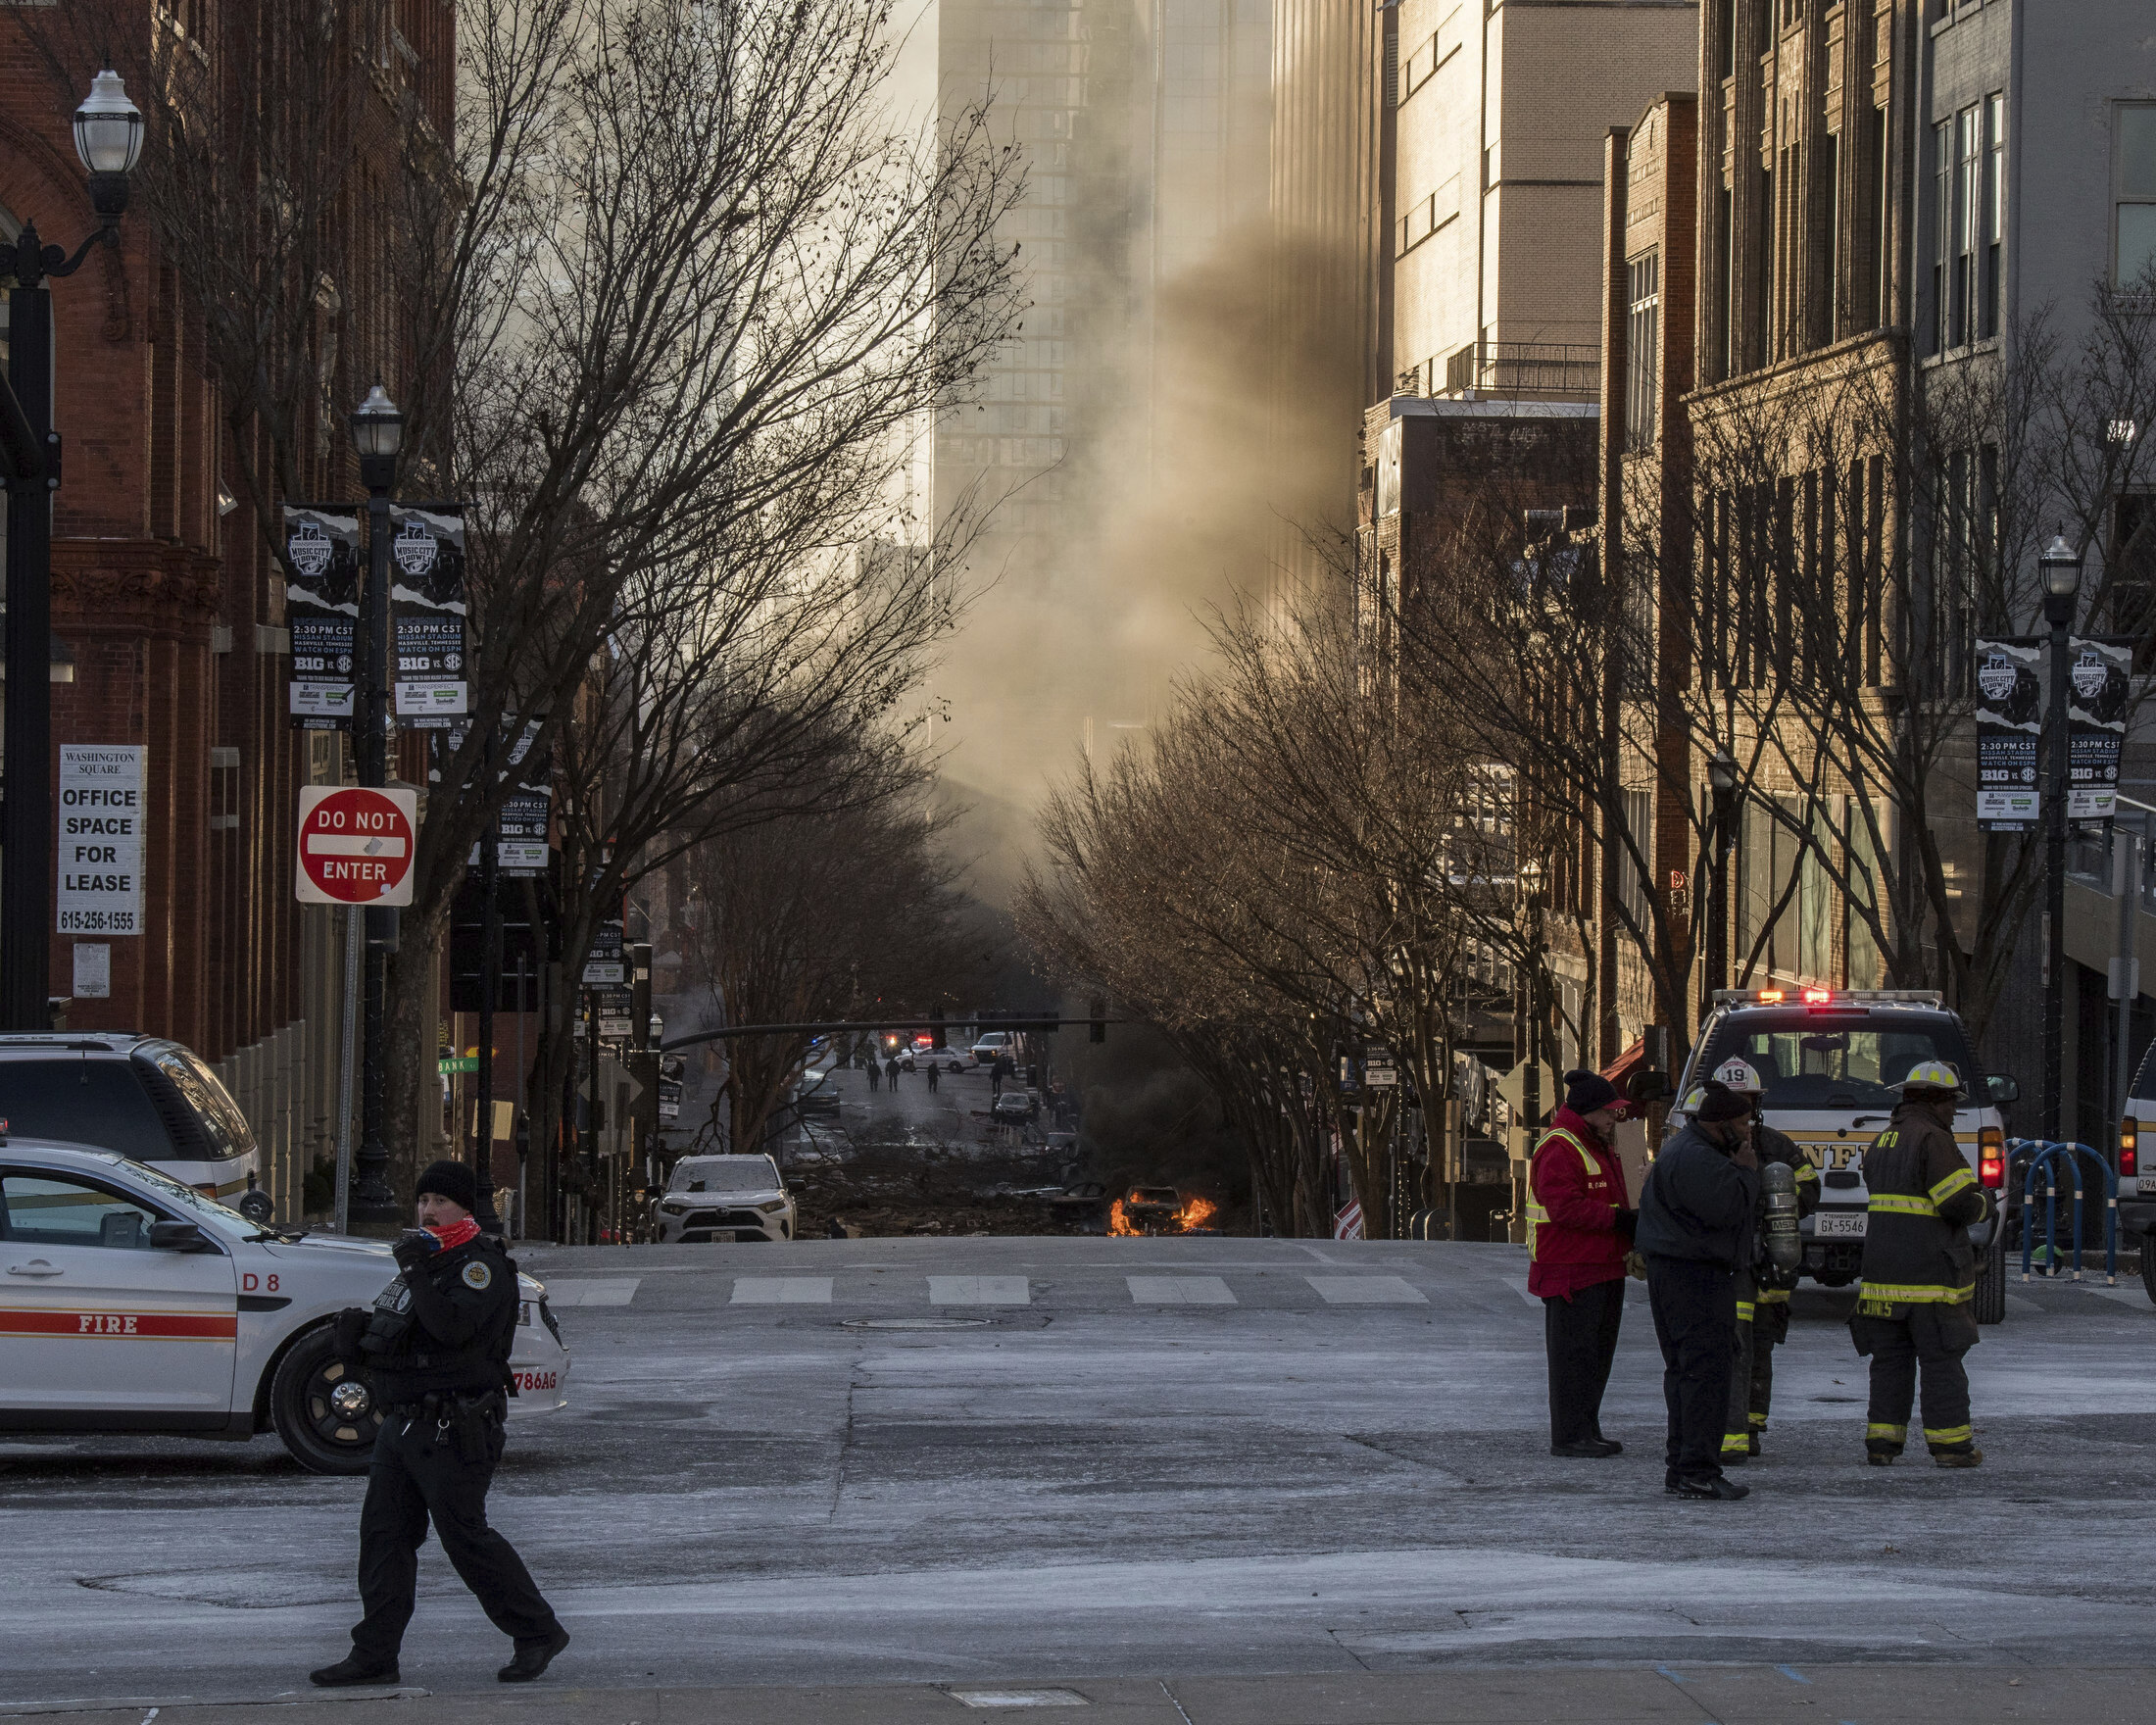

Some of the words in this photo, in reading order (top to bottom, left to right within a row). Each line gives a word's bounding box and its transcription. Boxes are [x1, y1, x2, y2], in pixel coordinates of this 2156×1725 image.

[291, 548, 313, 558] MUSIC
[314, 548, 330, 558] CITY
[396, 547, 417, 557] MUSIC
[419, 547, 436, 557] CITY
[66, 753, 135, 763] WASHINGTON
[79, 764, 121, 775] SQUARE
[63, 789, 136, 806] OFFICE
[66, 818, 132, 835] SPACE
[318, 811, 345, 828] DO
[356, 812, 397, 830] NOT
[75, 847, 117, 863] FOR
[323, 862, 387, 881] ENTER
[66, 874, 131, 891] LEASE
[61, 911, 133, 930] 615-256-1555
[439, 1061, 465, 1072] BANK
[1727, 1069, 1744, 1081] 19
[1877, 1131, 1899, 1147] NFD
[1821, 1220, 1863, 1232] GX-5546
[243, 1273, 258, 1291] D
[267, 1274, 279, 1292] 8
[375, 1294, 398, 1309] POLICE
[79, 1315, 137, 1333] FIRE
[514, 1372, 556, 1390] 786AG
